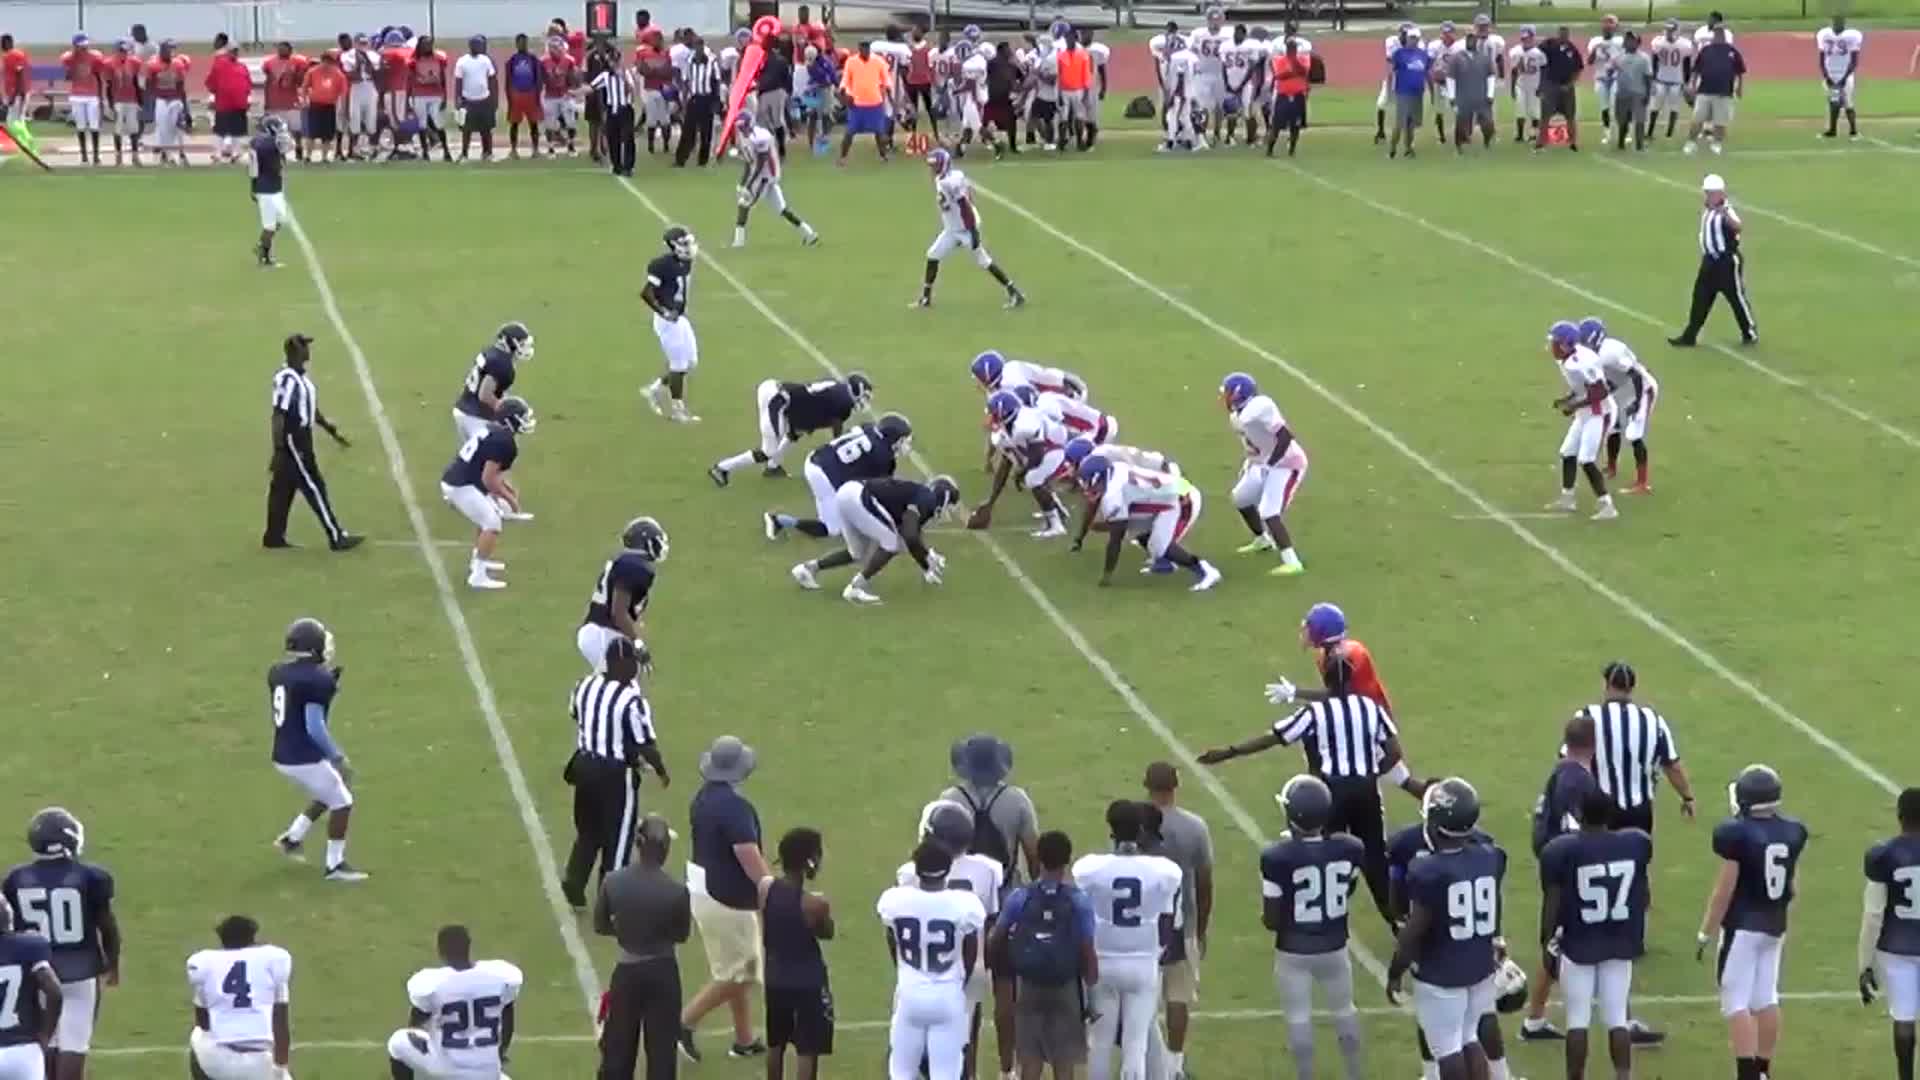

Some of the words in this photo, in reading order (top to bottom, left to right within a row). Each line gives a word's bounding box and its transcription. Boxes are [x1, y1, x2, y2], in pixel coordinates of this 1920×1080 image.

[905, 132, 928, 155] 40
[272, 685, 287, 728] 9
[1292, 860, 1352, 922] 26
[1577, 860, 1636, 923] 57
[1765, 842, 1789, 899] 6
[1893, 866, 1920, 919] 3
[17, 887, 84, 944] 50
[1112, 877, 1142, 927] 2
[1448, 876, 1496, 940] 99
[894, 917, 956, 974] 82
[222, 960, 251, 1008] 4
[440, 996, 501, 1049] 25
